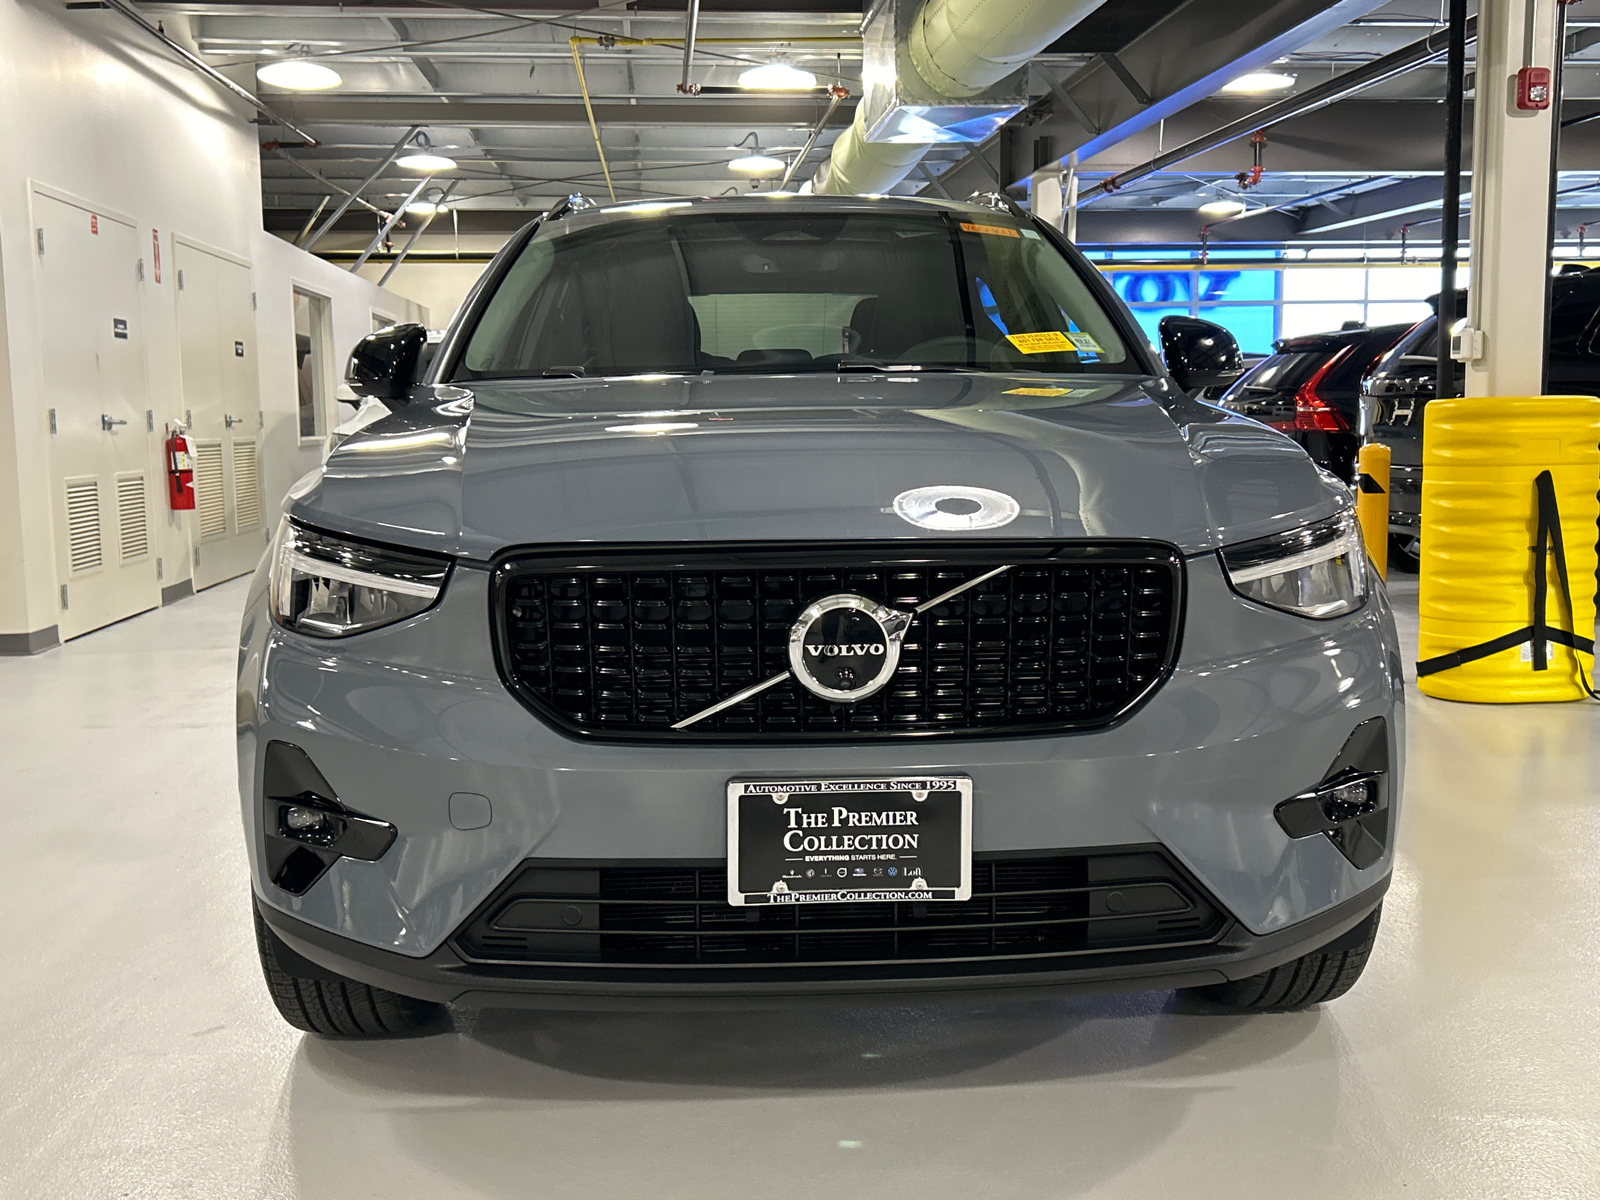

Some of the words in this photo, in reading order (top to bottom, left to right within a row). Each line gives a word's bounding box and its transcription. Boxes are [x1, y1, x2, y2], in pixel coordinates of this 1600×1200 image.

[805, 643, 885, 657] VOLVO
[746, 783, 818, 793] AUTOMOTIVE
[821, 782, 888, 792] EXCELLENCE
[890, 781, 921, 790] SINCE
[925, 780, 955, 790] 1995
[783, 807, 828, 829] THE
[831, 806, 919, 828] PREMIER
[783, 829, 919, 852] COLLECTION
